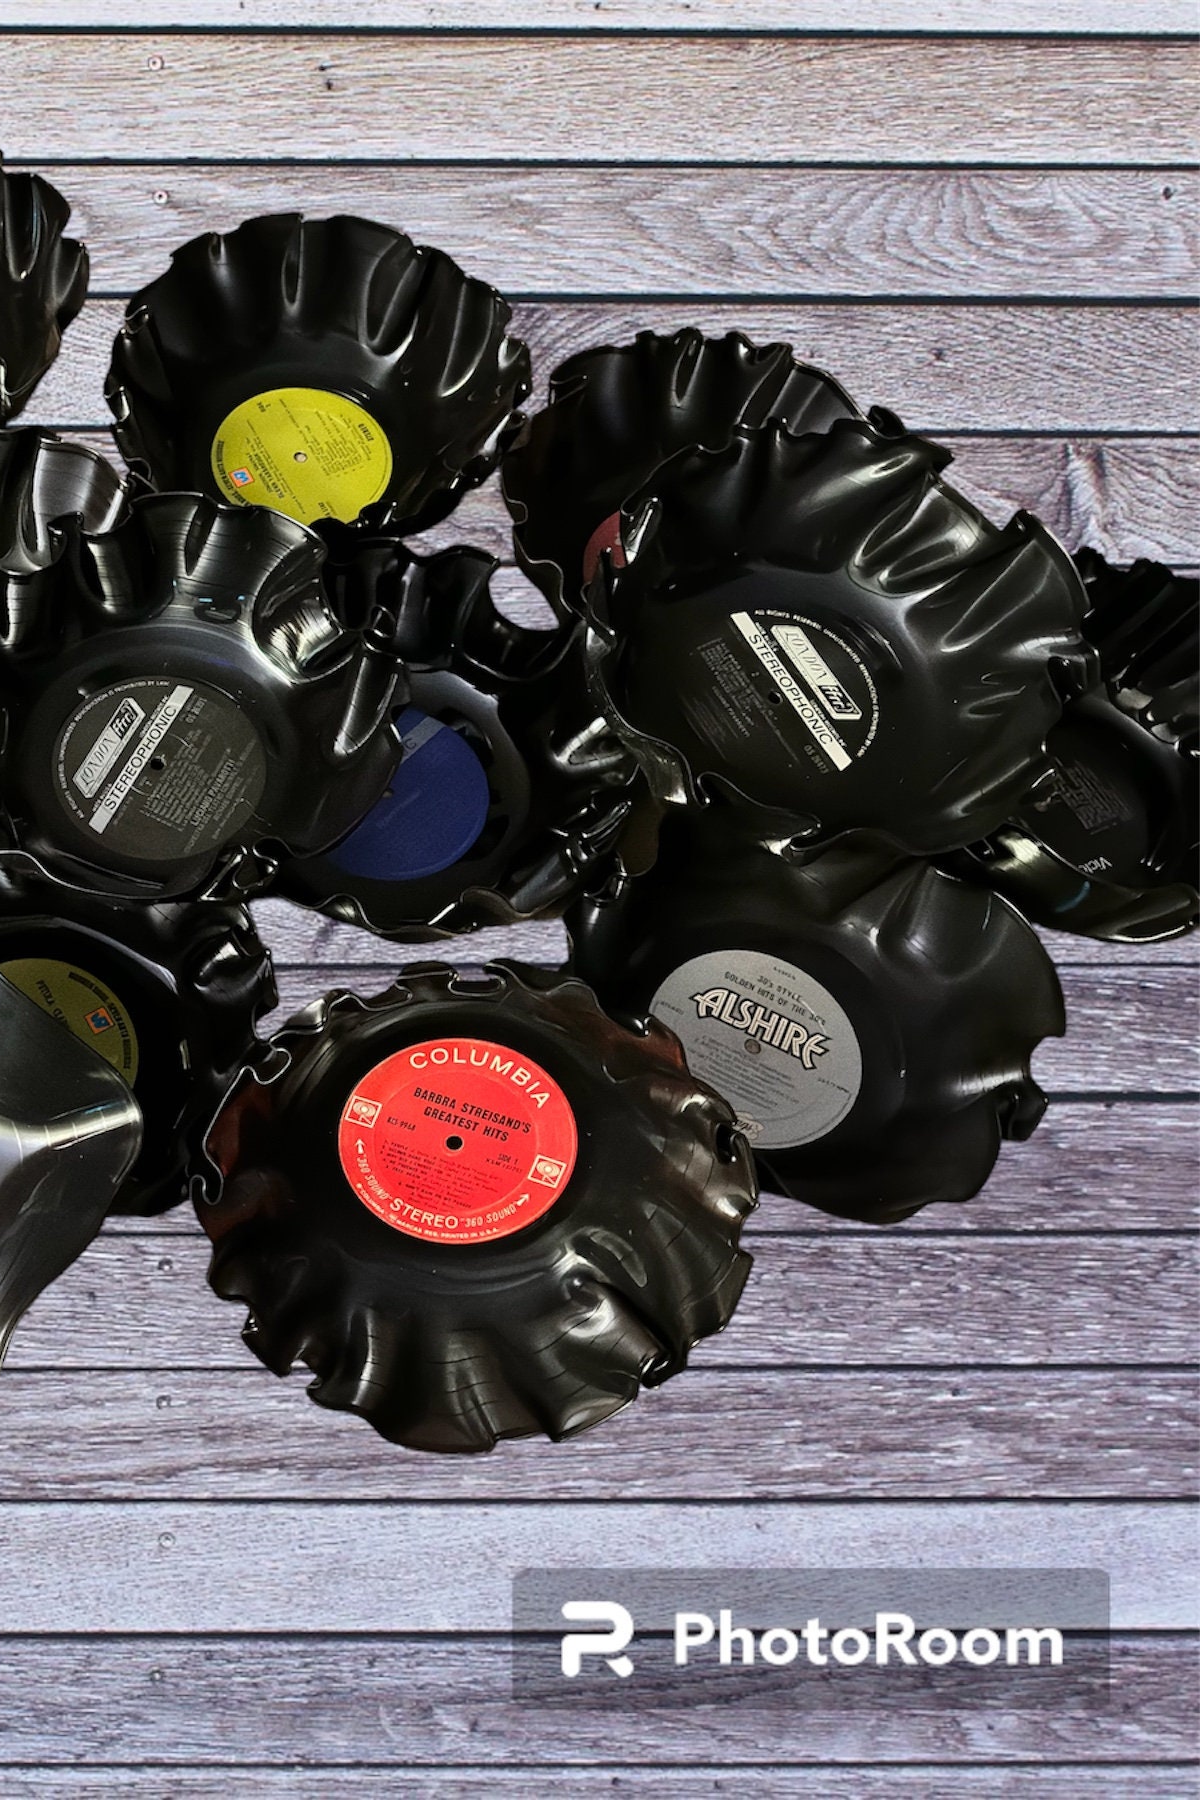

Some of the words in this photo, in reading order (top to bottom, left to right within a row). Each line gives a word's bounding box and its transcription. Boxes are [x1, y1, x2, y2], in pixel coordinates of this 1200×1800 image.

[786, 632, 828, 680] LONDON
[749, 634, 833, 744] STEREOPHONIC
[79, 727, 117, 786] LONDON
[104, 705, 176, 810] STEREOPHONIC
[724, 972, 755, 990] GOLDEN
[756, 987, 774, 1001] HITS
[777, 997, 787, 1006] OF
[689, 987, 833, 1070] ALSHIRE
[409, 1048, 551, 1109] COLUMBIA
[413, 1088, 456, 1108] BARBRA
[460, 1104, 530, 1132] STREISAND'S
[423, 1107, 479, 1130] GREATEST
[482, 1125, 508, 1141] HITS
[390, 1198, 458, 1229] STEREO
